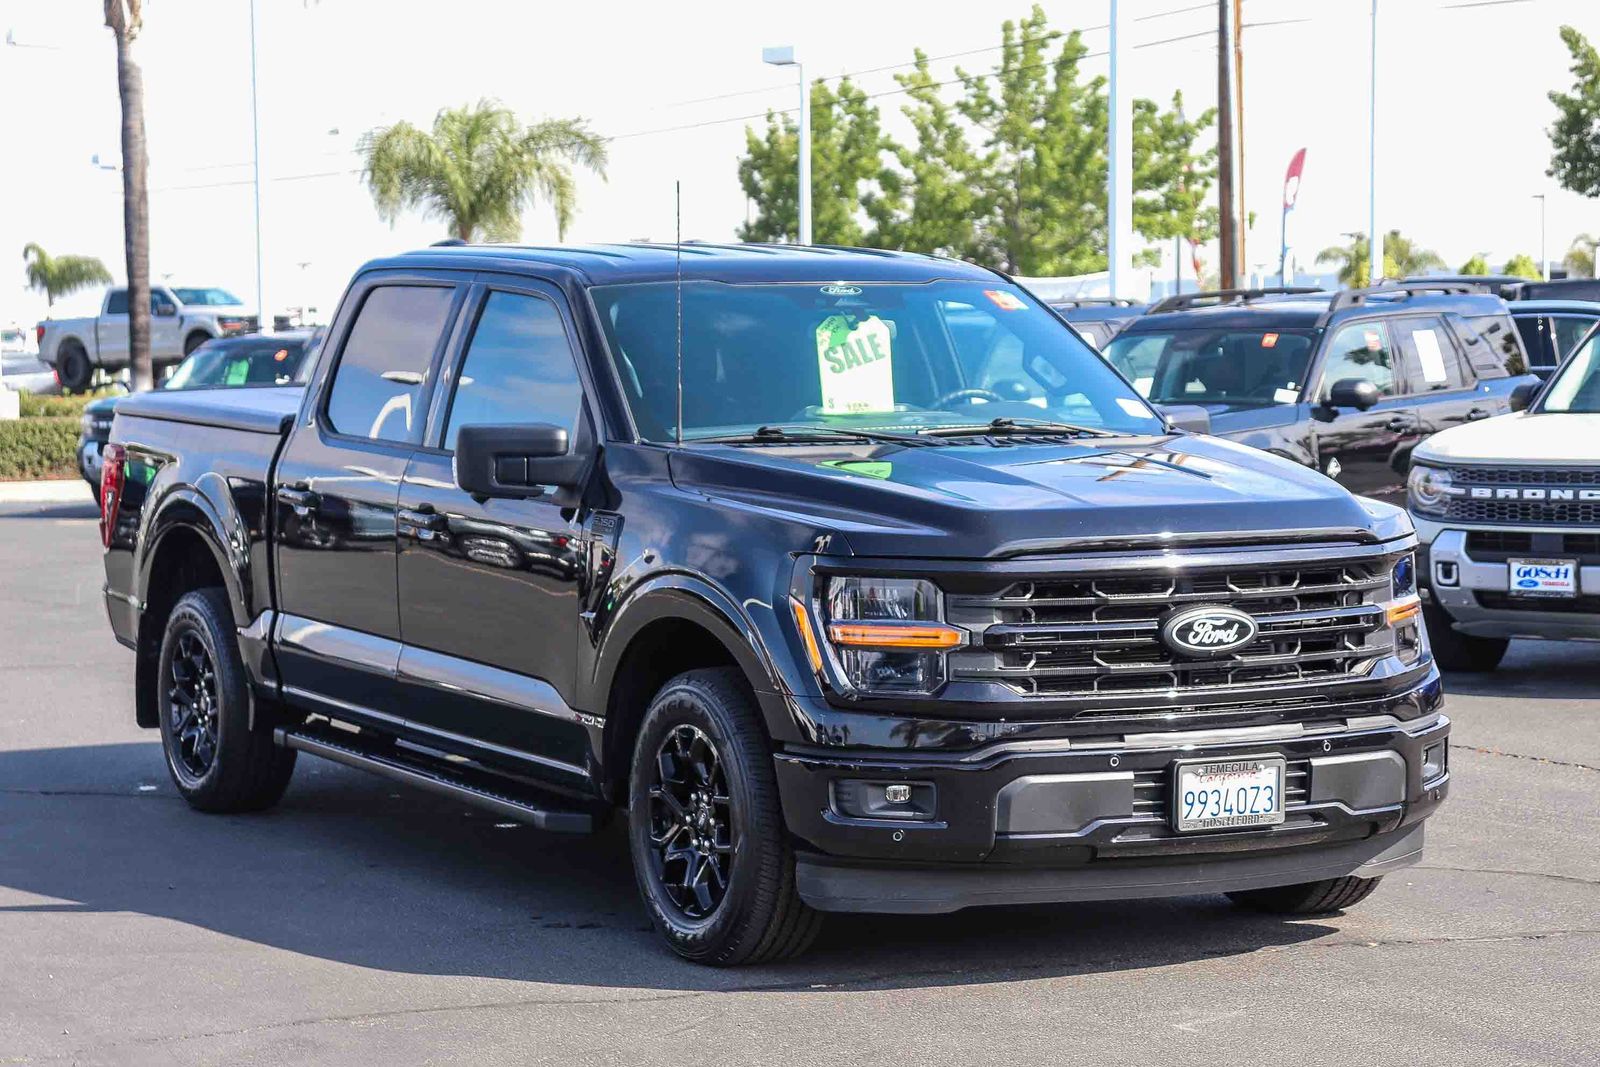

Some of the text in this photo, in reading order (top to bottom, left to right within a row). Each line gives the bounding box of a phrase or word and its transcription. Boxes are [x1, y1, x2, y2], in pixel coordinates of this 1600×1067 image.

[824, 333, 886, 374] SALE
[1471, 487, 1600, 500] BRONC
[1516, 566, 1569, 579] GOSCH
[1187, 619, 1240, 645] Ford
[1203, 761, 1259, 775] TEMECULA
